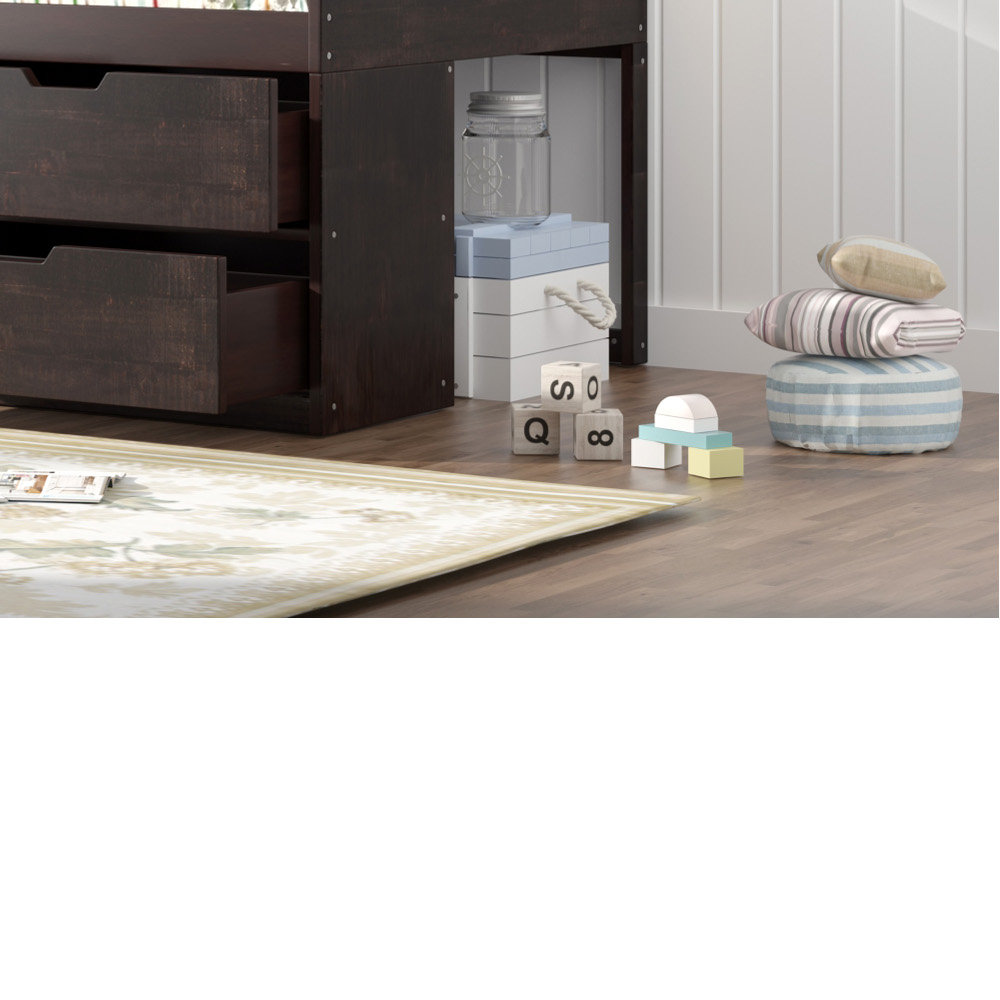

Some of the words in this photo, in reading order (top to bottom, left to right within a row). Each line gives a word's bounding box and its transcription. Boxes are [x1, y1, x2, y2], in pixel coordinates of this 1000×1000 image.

[549, 379, 575, 401] S
[523, 417, 549, 446] Q
[587, 429, 614, 447] 8
